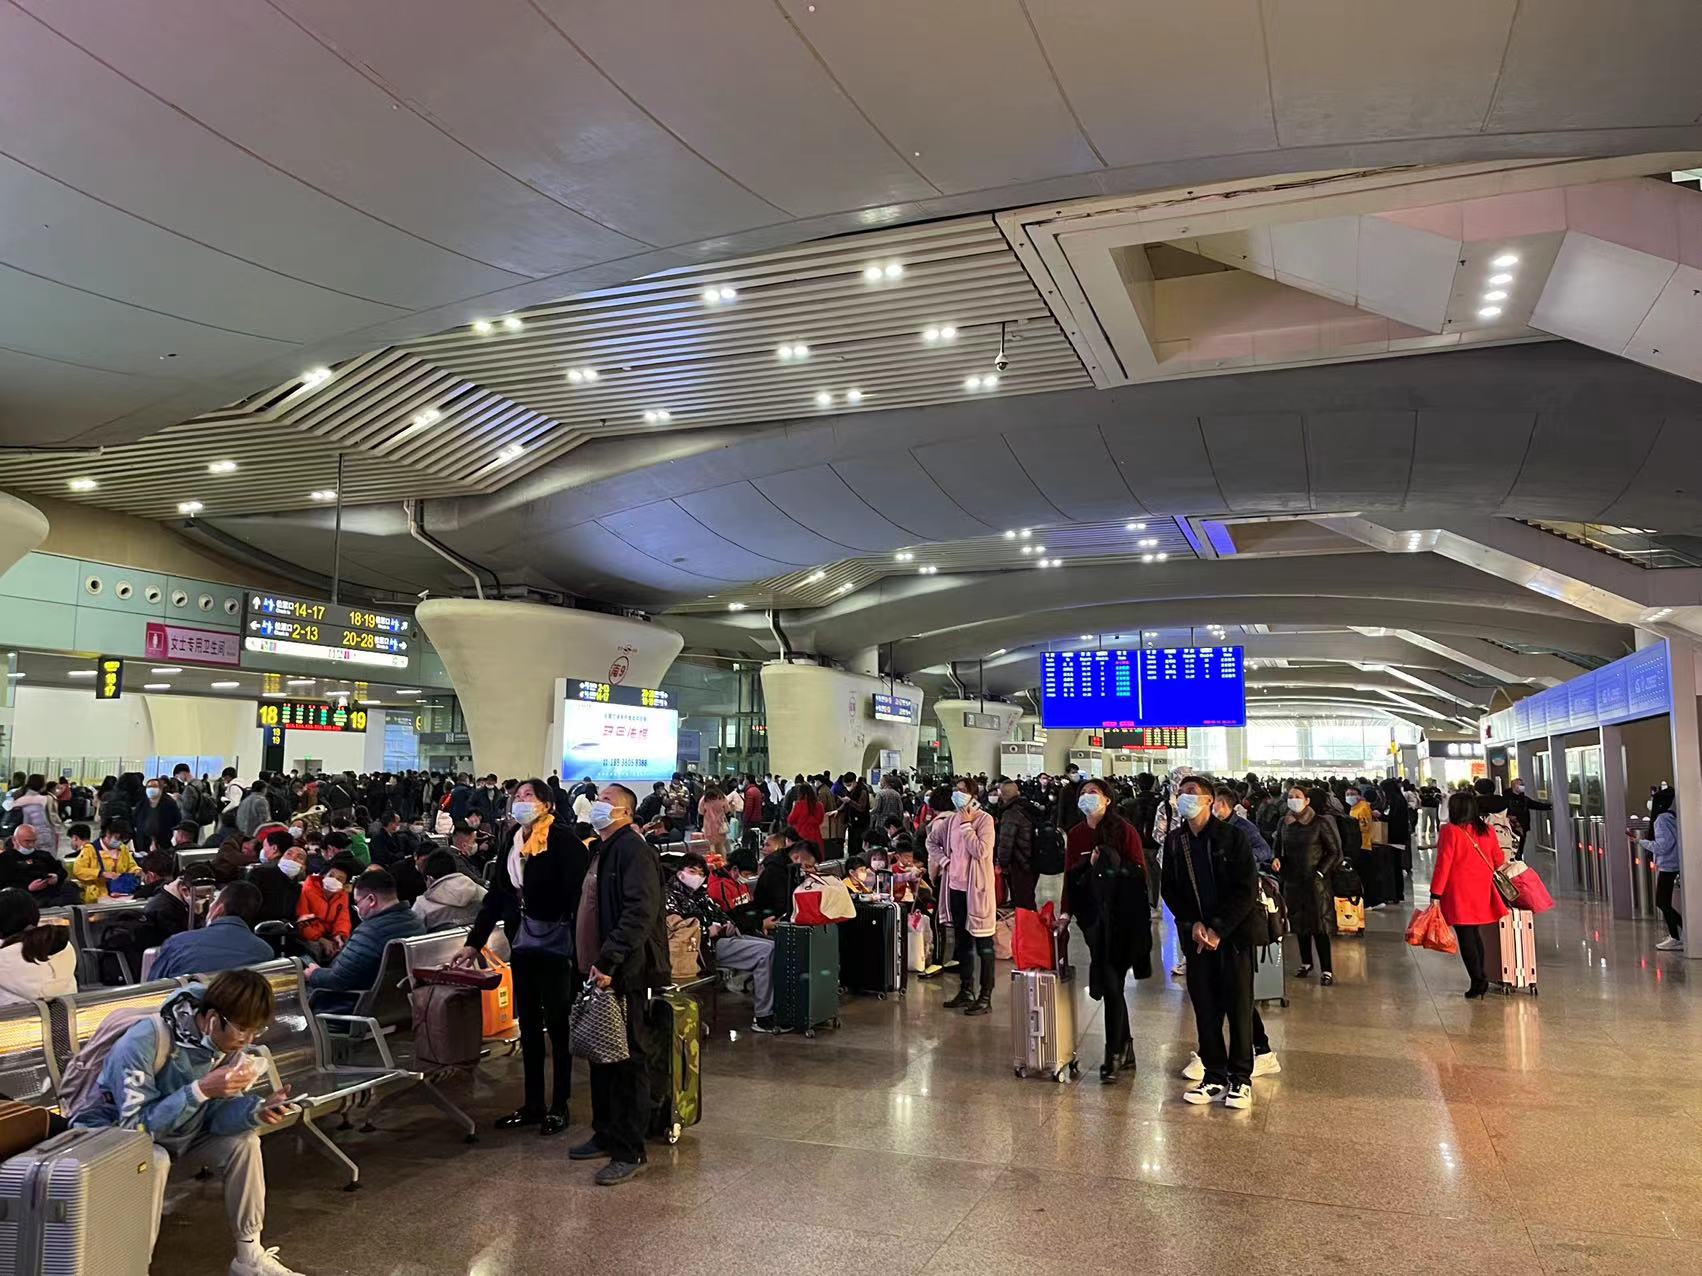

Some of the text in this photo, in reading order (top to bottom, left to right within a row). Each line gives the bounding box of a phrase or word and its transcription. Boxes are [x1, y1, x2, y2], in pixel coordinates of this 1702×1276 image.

[294, 602, 326, 620] 14-17
[292, 624, 319, 640] 2-13
[343, 631, 374, 648] 20-28
[260, 705, 279, 725] 18
[351, 711, 367, 729] 19
